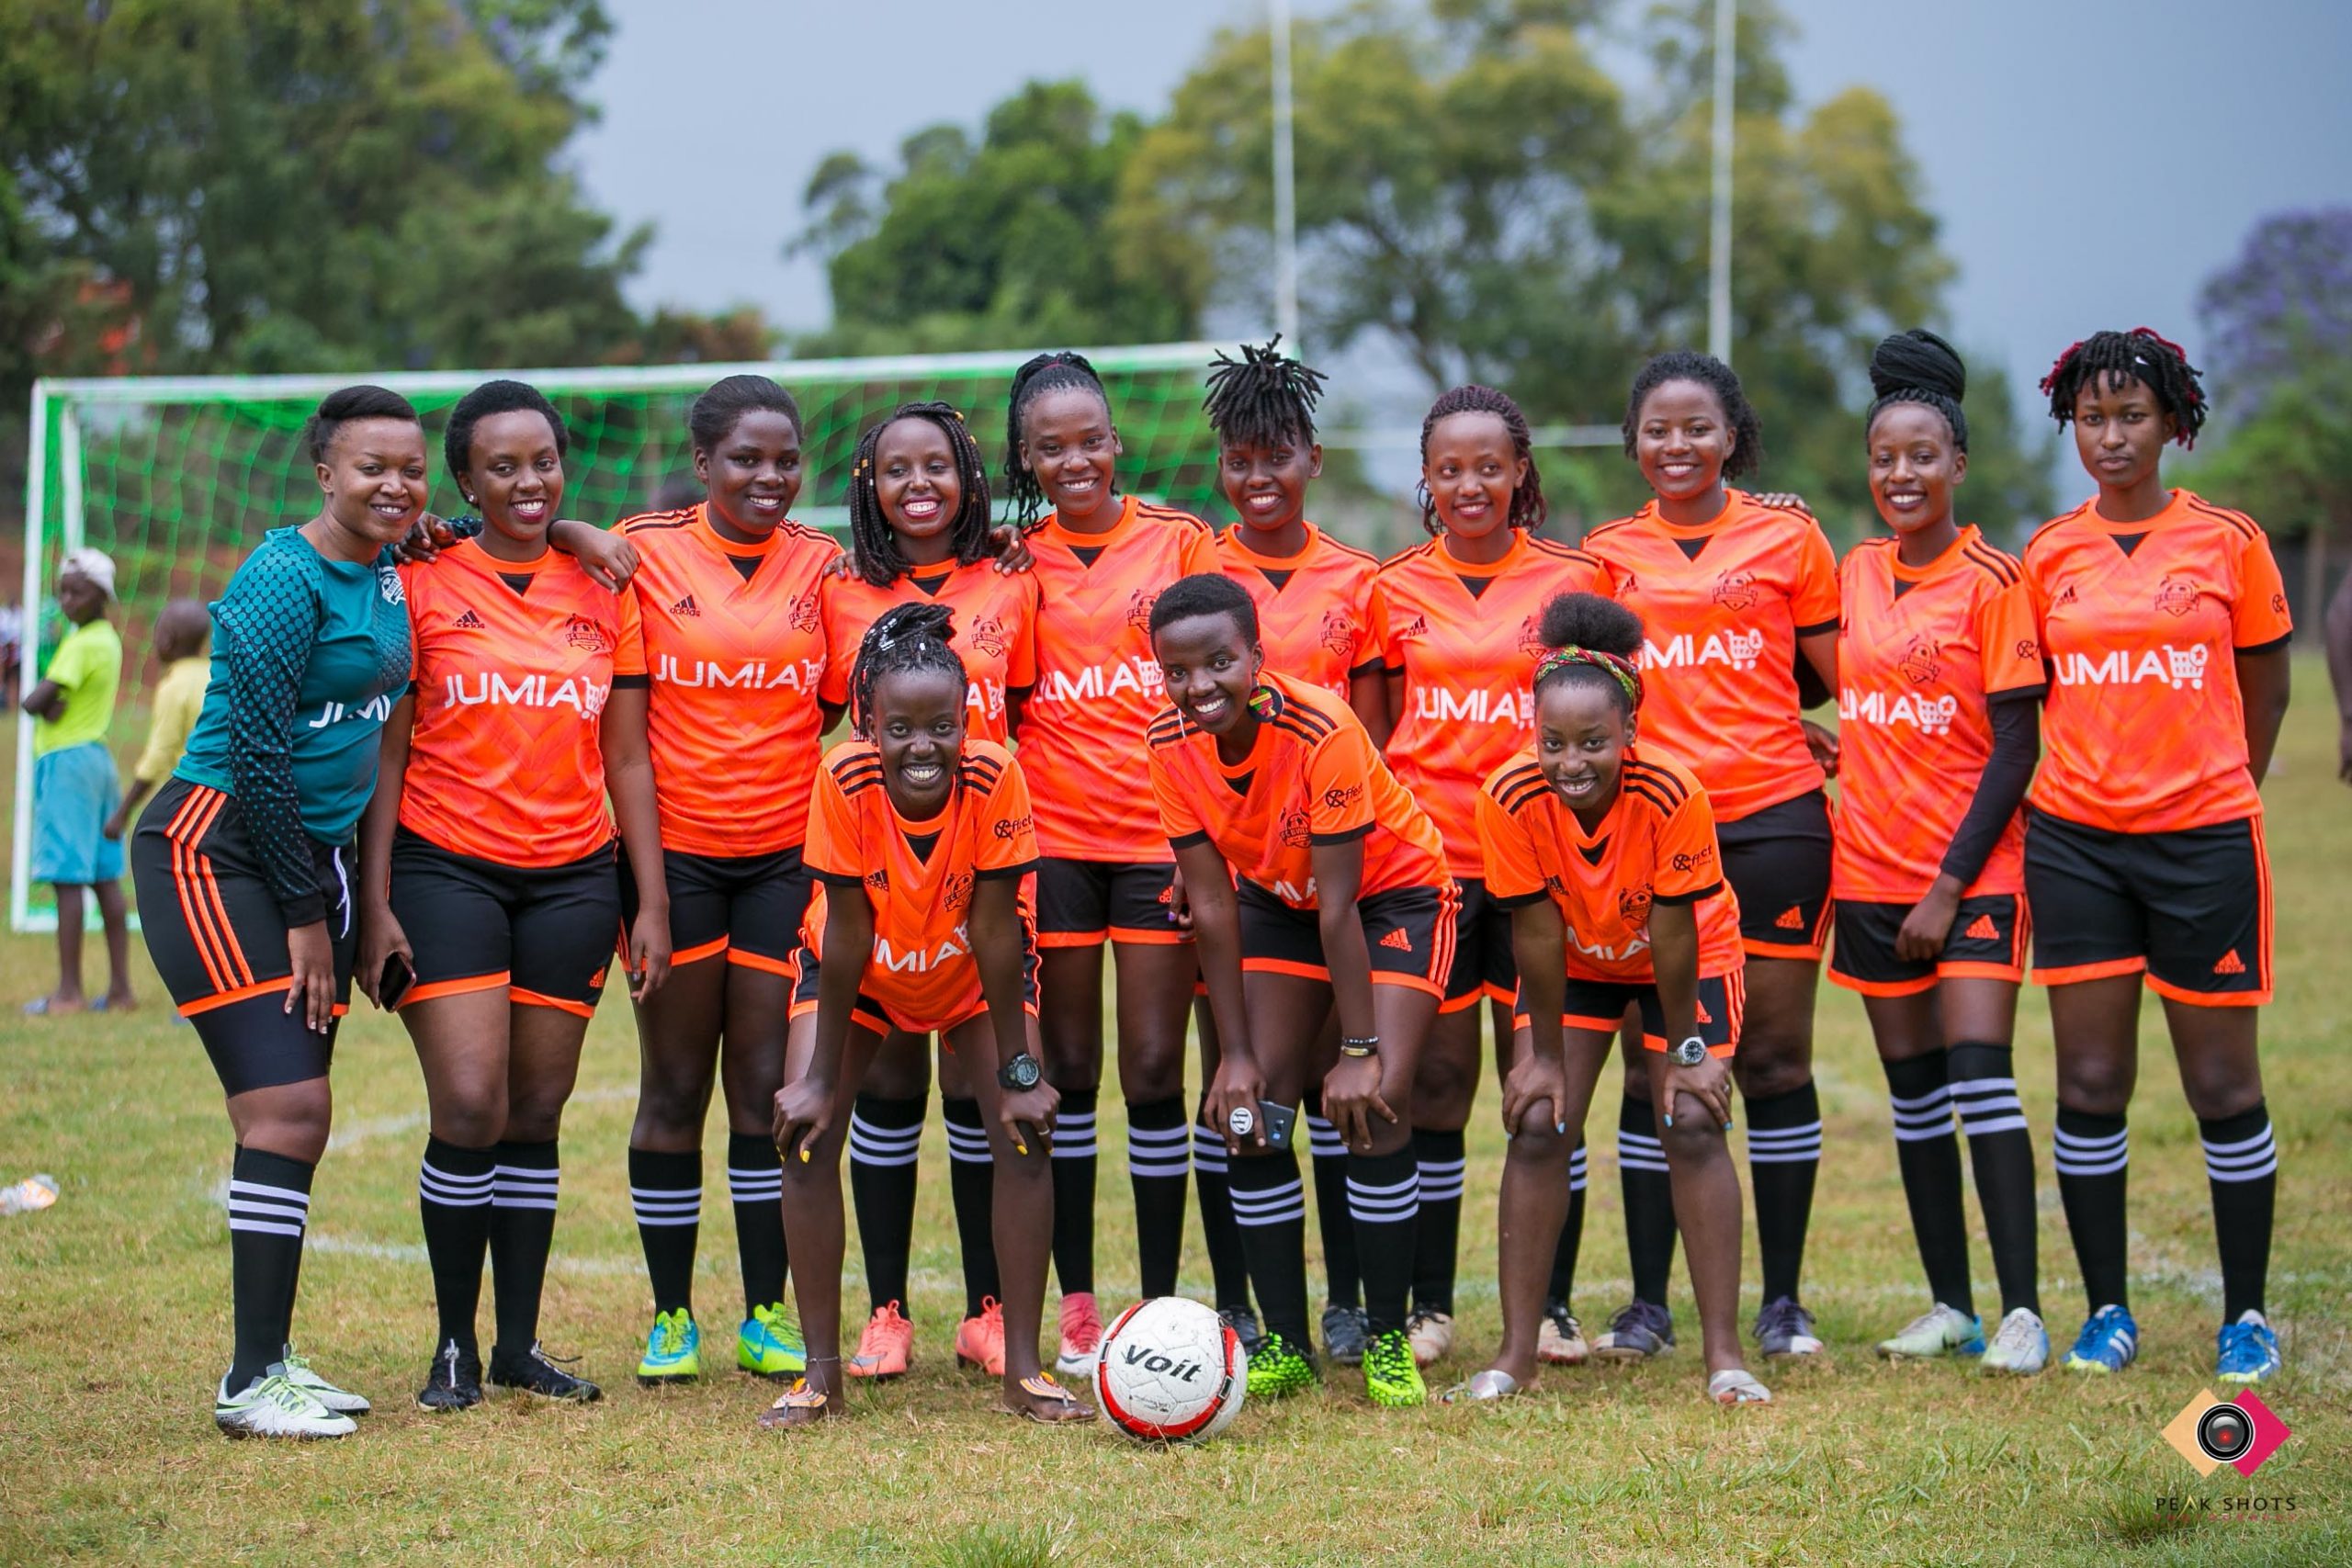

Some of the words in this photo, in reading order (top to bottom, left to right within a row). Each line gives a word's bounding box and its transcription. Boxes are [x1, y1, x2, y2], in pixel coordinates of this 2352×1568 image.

[670, 606, 700, 616] adidas
[655, 654, 801, 691] JUMIA
[445, 672, 582, 712] JUMIA
[864, 877, 890, 892] adida
[875, 932, 964, 973] MIA
[1380, 939, 1412, 952] adidas
